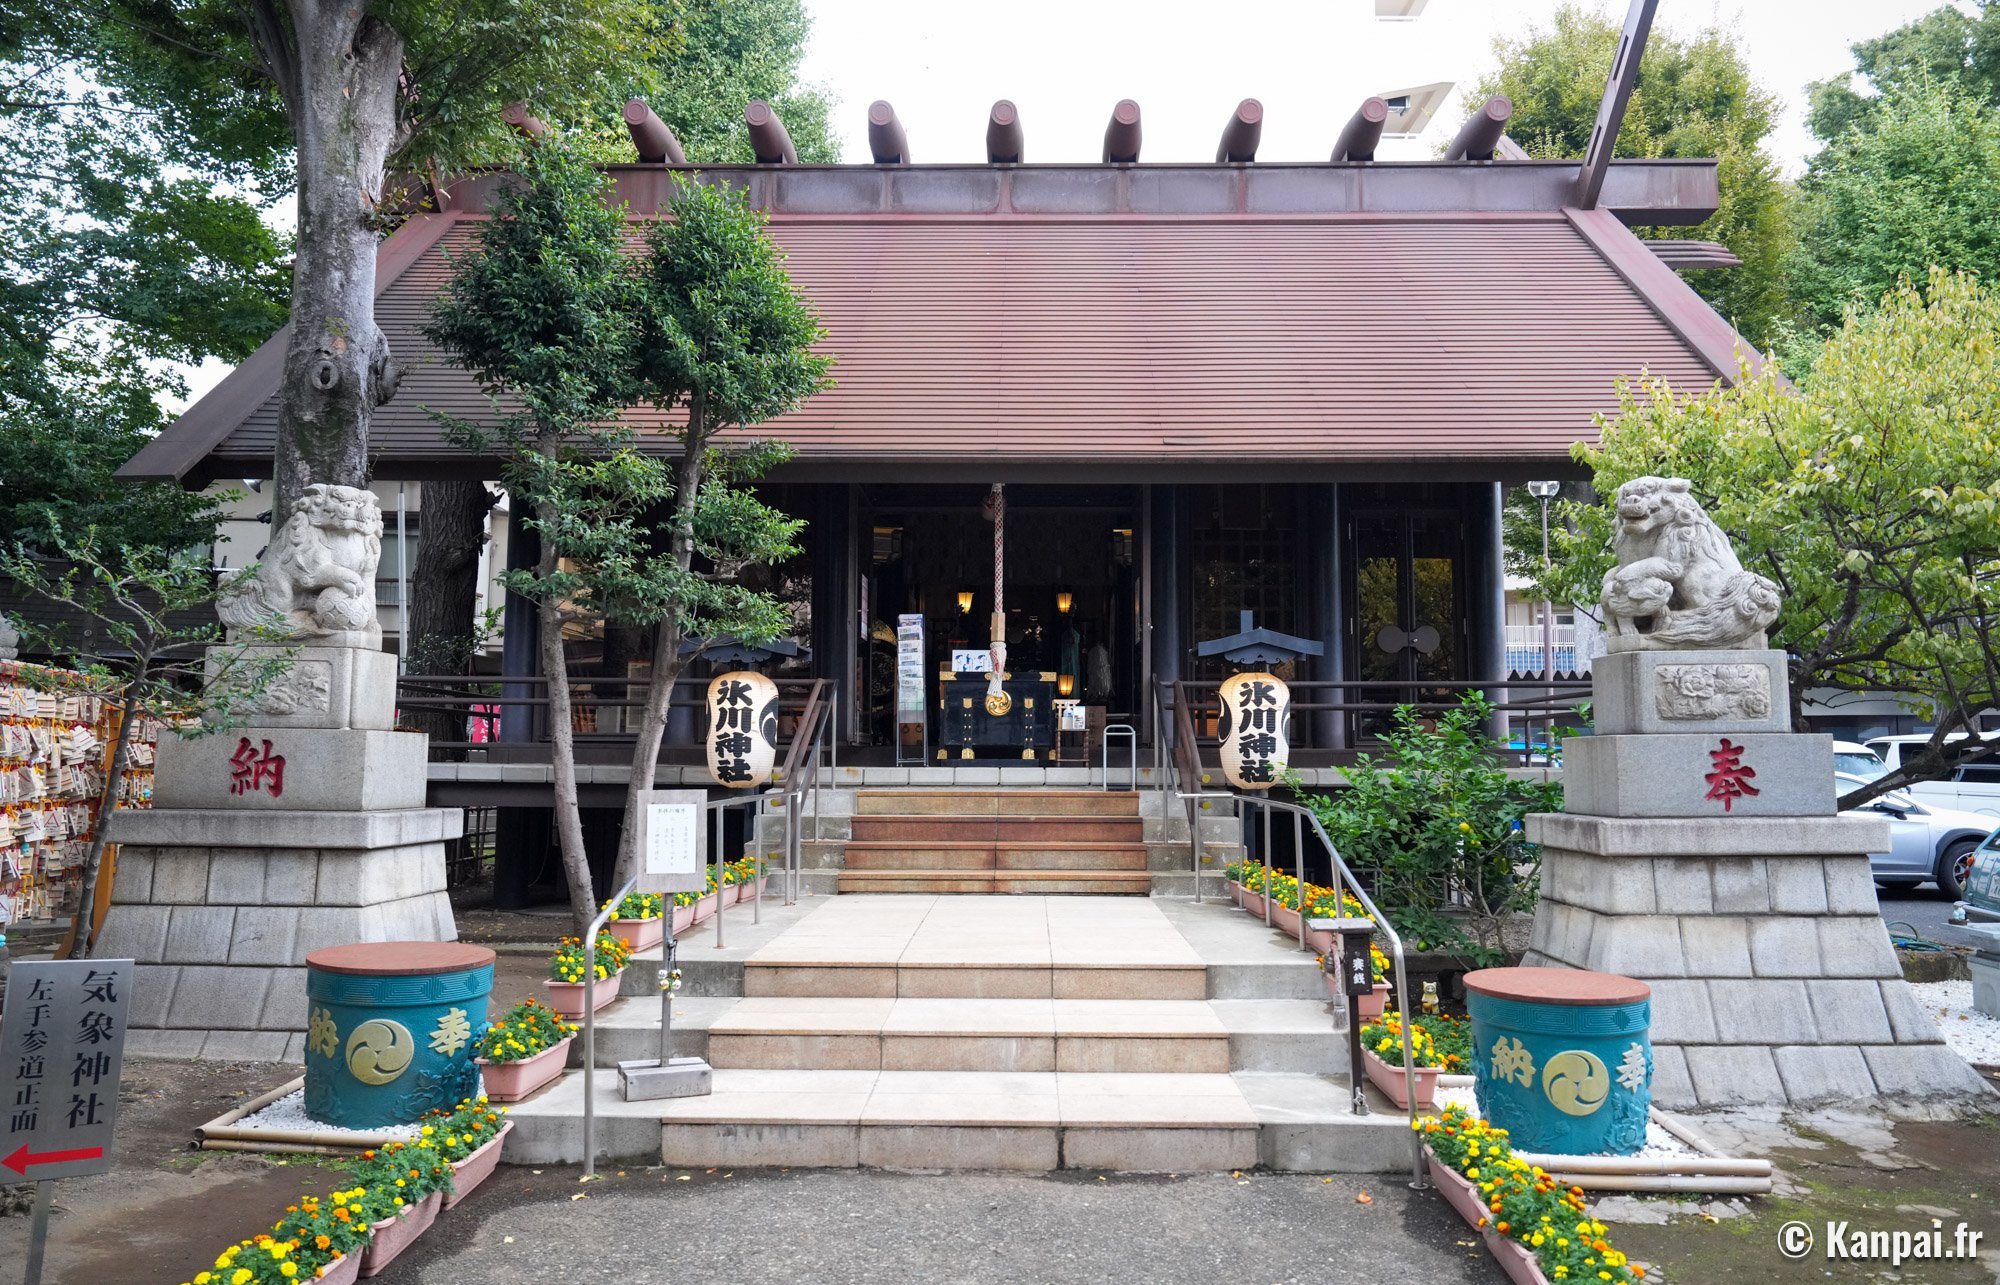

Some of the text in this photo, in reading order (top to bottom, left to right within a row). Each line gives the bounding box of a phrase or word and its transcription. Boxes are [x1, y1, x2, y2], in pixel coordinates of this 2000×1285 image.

[229, 737, 287, 799] 納
[715, 680, 754, 783] 氷川神社
[1238, 681, 1277, 783] 氷川神社
[1705, 738, 1760, 812] 奉
[10, 978, 55, 1133] 左手参道正面
[64, 970, 119, 1130] 気象神社
[309, 1006, 472, 1059] 奉 納
[1491, 1035, 1646, 1094] 奉 納
